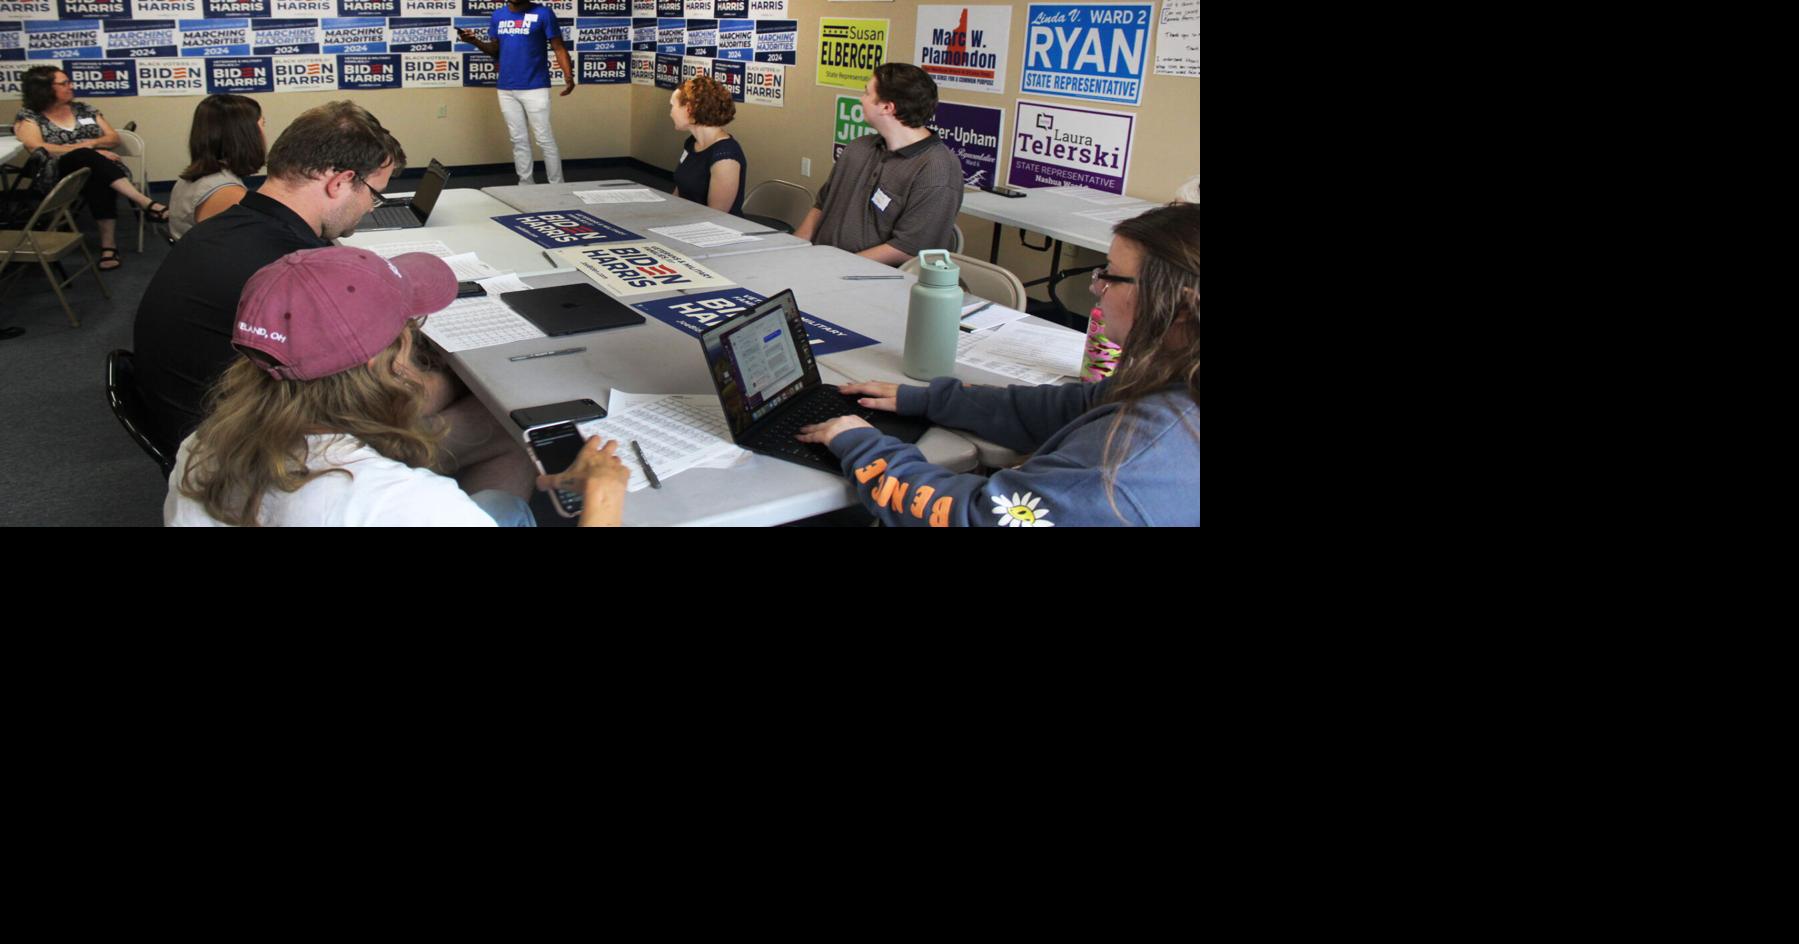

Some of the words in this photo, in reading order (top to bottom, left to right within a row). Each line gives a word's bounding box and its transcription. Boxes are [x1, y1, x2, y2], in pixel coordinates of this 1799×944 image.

[66, 4, 124, 13] HARRIS
[138, 3, 195, 11] HARRIS
[210, 3, 264, 12] HARRIS
[277, 2, 330, 10] HARRIS
[344, 3, 394, 11] HARRIS
[406, 2, 456, 10] HARRIS
[584, 3, 626, 11] HARRIS
[686, 2, 711, 10] HARRIS
[718, 1, 745, 11] HARRIS
[751, 1, 784, 10] HARRIS
[1031, 11, 1066, 25] Linda
[1068, 8, 1081, 22] V.
[1090, 10, 1134, 25] WARD
[1137, 10, 1147, 25] 2
[498, 19, 531, 29] BIDEN
[29, 31, 97, 41] MARCHING
[108, 31, 173, 40] MARCHING
[183, 29, 245, 39] MARCHING
[256, 28, 315, 37] MARCHING
[325, 27, 383, 37] MARCHING
[392, 27, 448, 36] MARCHING
[579, 27, 629, 36] MARCHING
[720, 32, 752, 40] MARCHING
[849, 26, 884, 41] Susan
[182, 38, 246, 47] MAJORITIES
[255, 37, 315, 45] MAJORITIES
[324, 35, 383, 45] MAJORITIES
[391, 35, 449, 43] MAJORITIES
[578, 34, 628, 43] MAJORITIES
[758, 33, 795, 42] MARCHING
[932, 28, 967, 47] Marc
[971, 29, 987, 48] W.
[29, 40, 97, 49] MAJORITIES
[108, 39, 173, 48] MAJORITIES
[410, 44, 433, 52] 2024
[595, 43, 615, 51] 2024
[719, 40, 752, 49] MAJORITIES
[757, 41, 794, 51] MAJORITIES
[52, 50, 80, 58] 2024
[129, 48, 157, 57] 2024
[203, 47, 229, 55] 2024
[274, 46, 300, 54] 2024
[344, 45, 368, 53] 2024
[727, 50, 742, 58] 2024
[1027, 26, 1146, 75] RYAN
[767, 53, 783, 62] 2024
[821, 41, 883, 70] ELBERGER
[922, 47, 997, 69] Plamondon
[275, 63, 333, 76] BIDEN
[344, 64, 393, 74] BIDEN
[405, 61, 459, 72] BIDEN
[583, 61, 626, 71] BIDEN
[632, 60, 655, 71] BIDEN
[656, 63, 680, 76] BIDEN
[0, 71, 22, 81] BID
[73, 70, 128, 81] BIDEN
[140, 68, 201, 79] BIDEN
[213, 68, 266, 78] BIDEN
[583, 70, 626, 79] HARRIS
[682, 65, 711, 77] BIDEN
[276, 75, 335, 85] HARRIS
[344, 74, 393, 83] HARRIS
[405, 72, 460, 81] HARRIS
[714, 72, 741, 85] BIDEN
[746, 72, 782, 87] BIDEN
[73, 81, 129, 90] HARRIS
[140, 79, 202, 89] HARRIS
[213, 78, 268, 87] HARRIS
[1026, 73, 1051, 89] STATE
[1054, 75, 1136, 97] REPRESENTATIVE
[746, 86, 782, 99] HARRIS
[1054, 129, 1093, 146] Laura
[1018, 133, 1119, 169] Telerski
[1016, 161, 1040, 173] STATE
[1041, 165, 1117, 188] REPRESENTATIVE
[514, 216, 580, 243] HARRIS
[537, 214, 608, 240] BIDEN
[582, 249, 658, 288] HARRIS
[608, 247, 692, 285] BIDEN
[270, 332, 287, 343] OH
